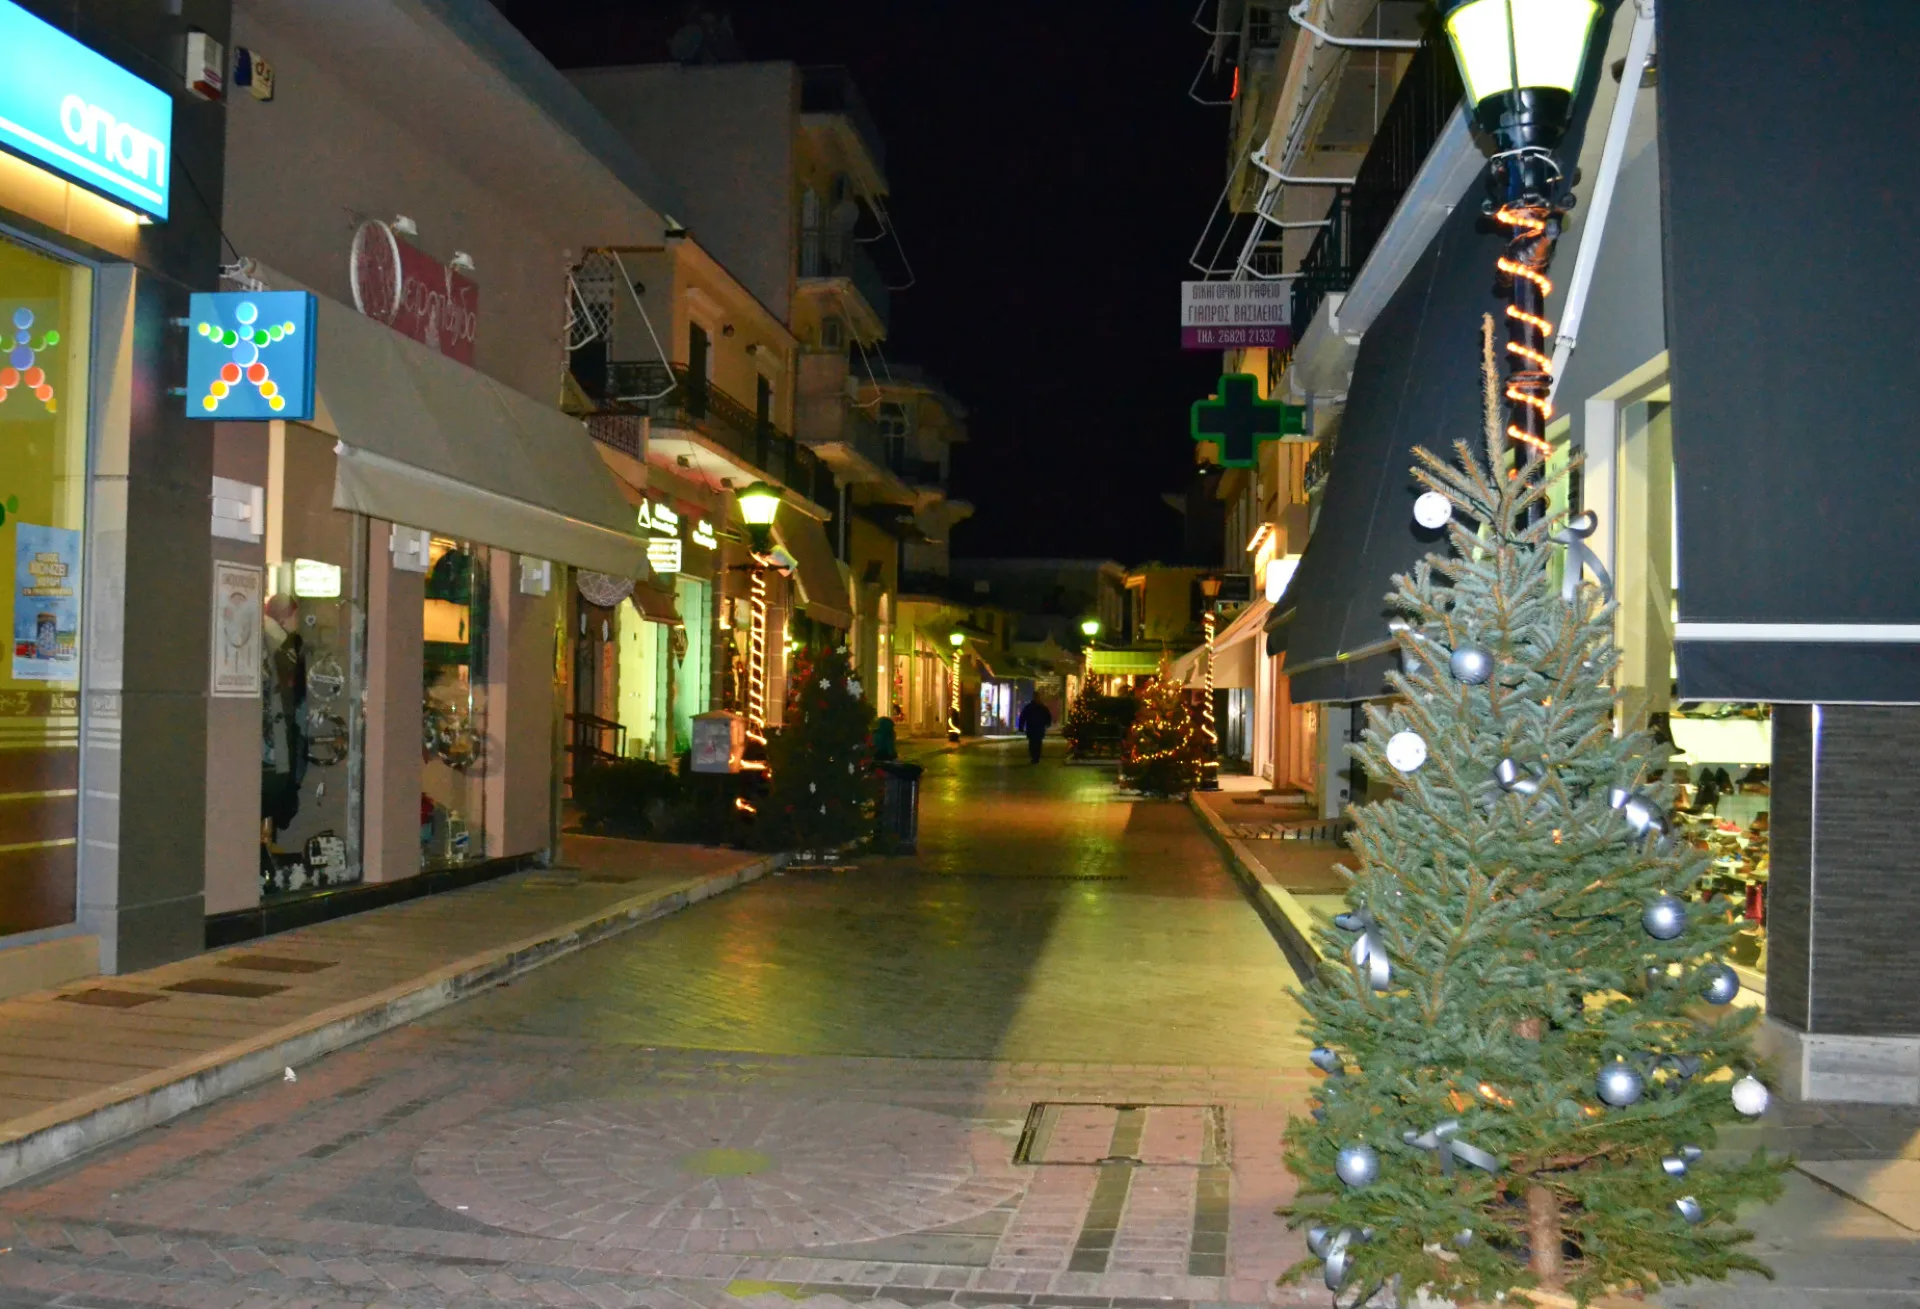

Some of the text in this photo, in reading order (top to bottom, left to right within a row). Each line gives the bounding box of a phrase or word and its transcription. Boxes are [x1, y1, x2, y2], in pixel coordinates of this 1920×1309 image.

[1244, 283, 1280, 299] ΓΡΑΦΕΙΟ
[1234, 304, 1284, 322] ΒΑΣΙΛΕΙΟΣ
[1218, 329, 1246, 343] 26820
[1248, 329, 1275, 343] 21332
